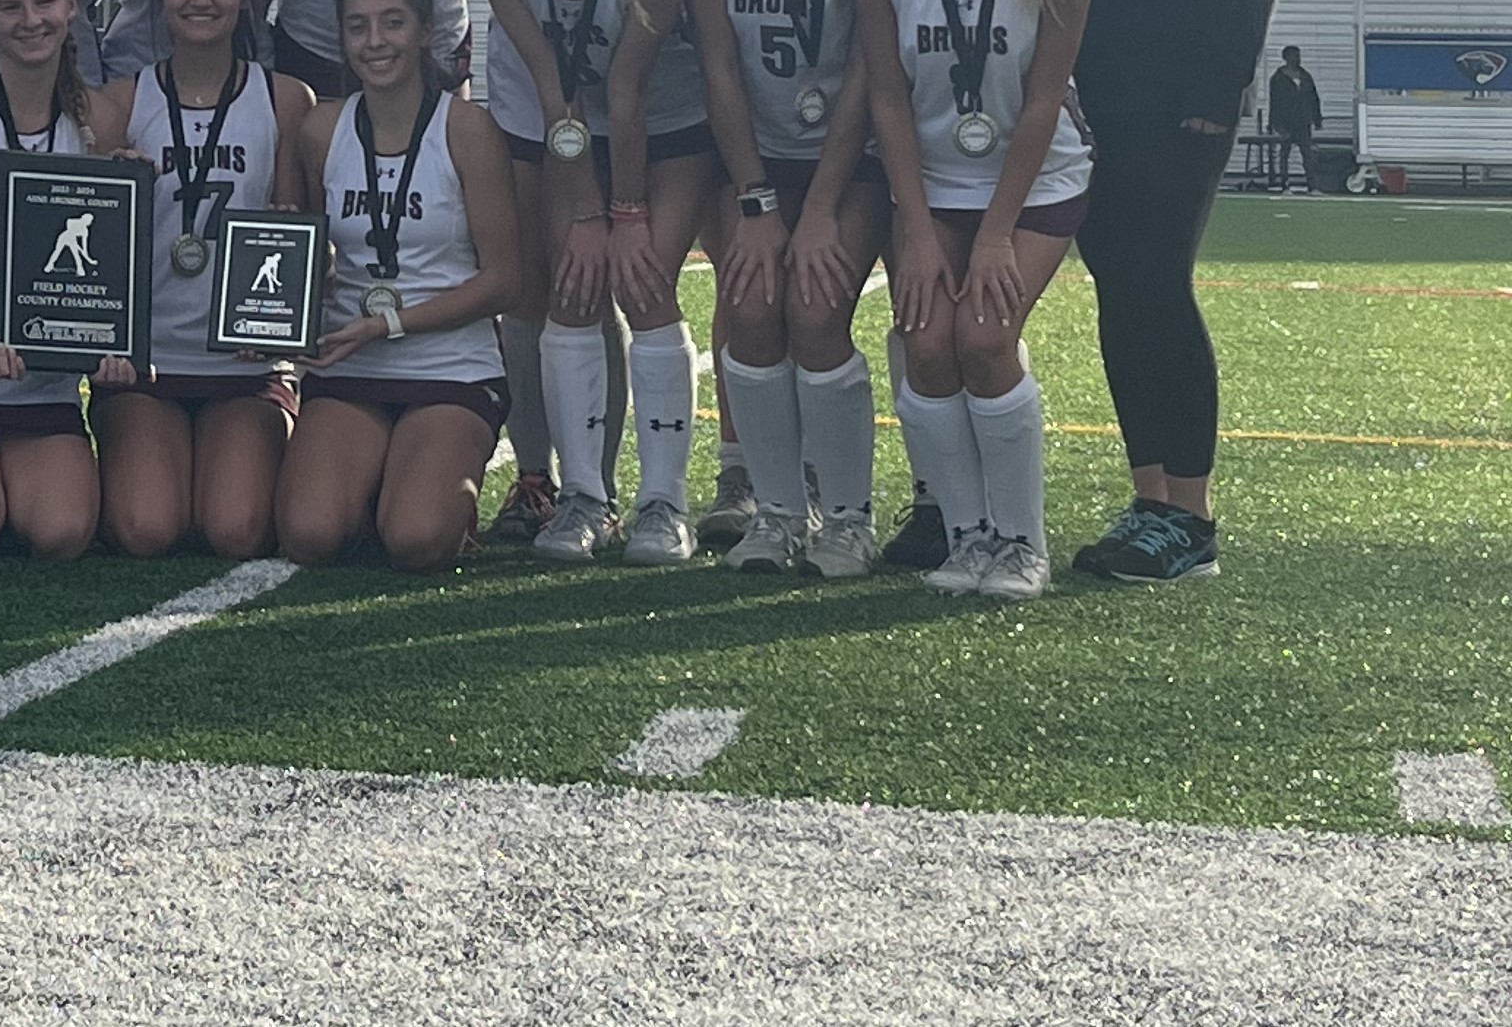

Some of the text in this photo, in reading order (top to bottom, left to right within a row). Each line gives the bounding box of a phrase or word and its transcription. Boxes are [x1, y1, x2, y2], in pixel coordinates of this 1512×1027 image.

[759, 25, 797, 78] 5
[917, 24, 1008, 55] BRIS
[162, 145, 246, 174] BUINS
[341, 189, 422, 220] BRIS
[17, 294, 124, 310] COUNTY CHAMPIONS
[33, 281, 108, 296] FIELD HOCKEY
[24, 319, 116, 344] ATHLETICS
